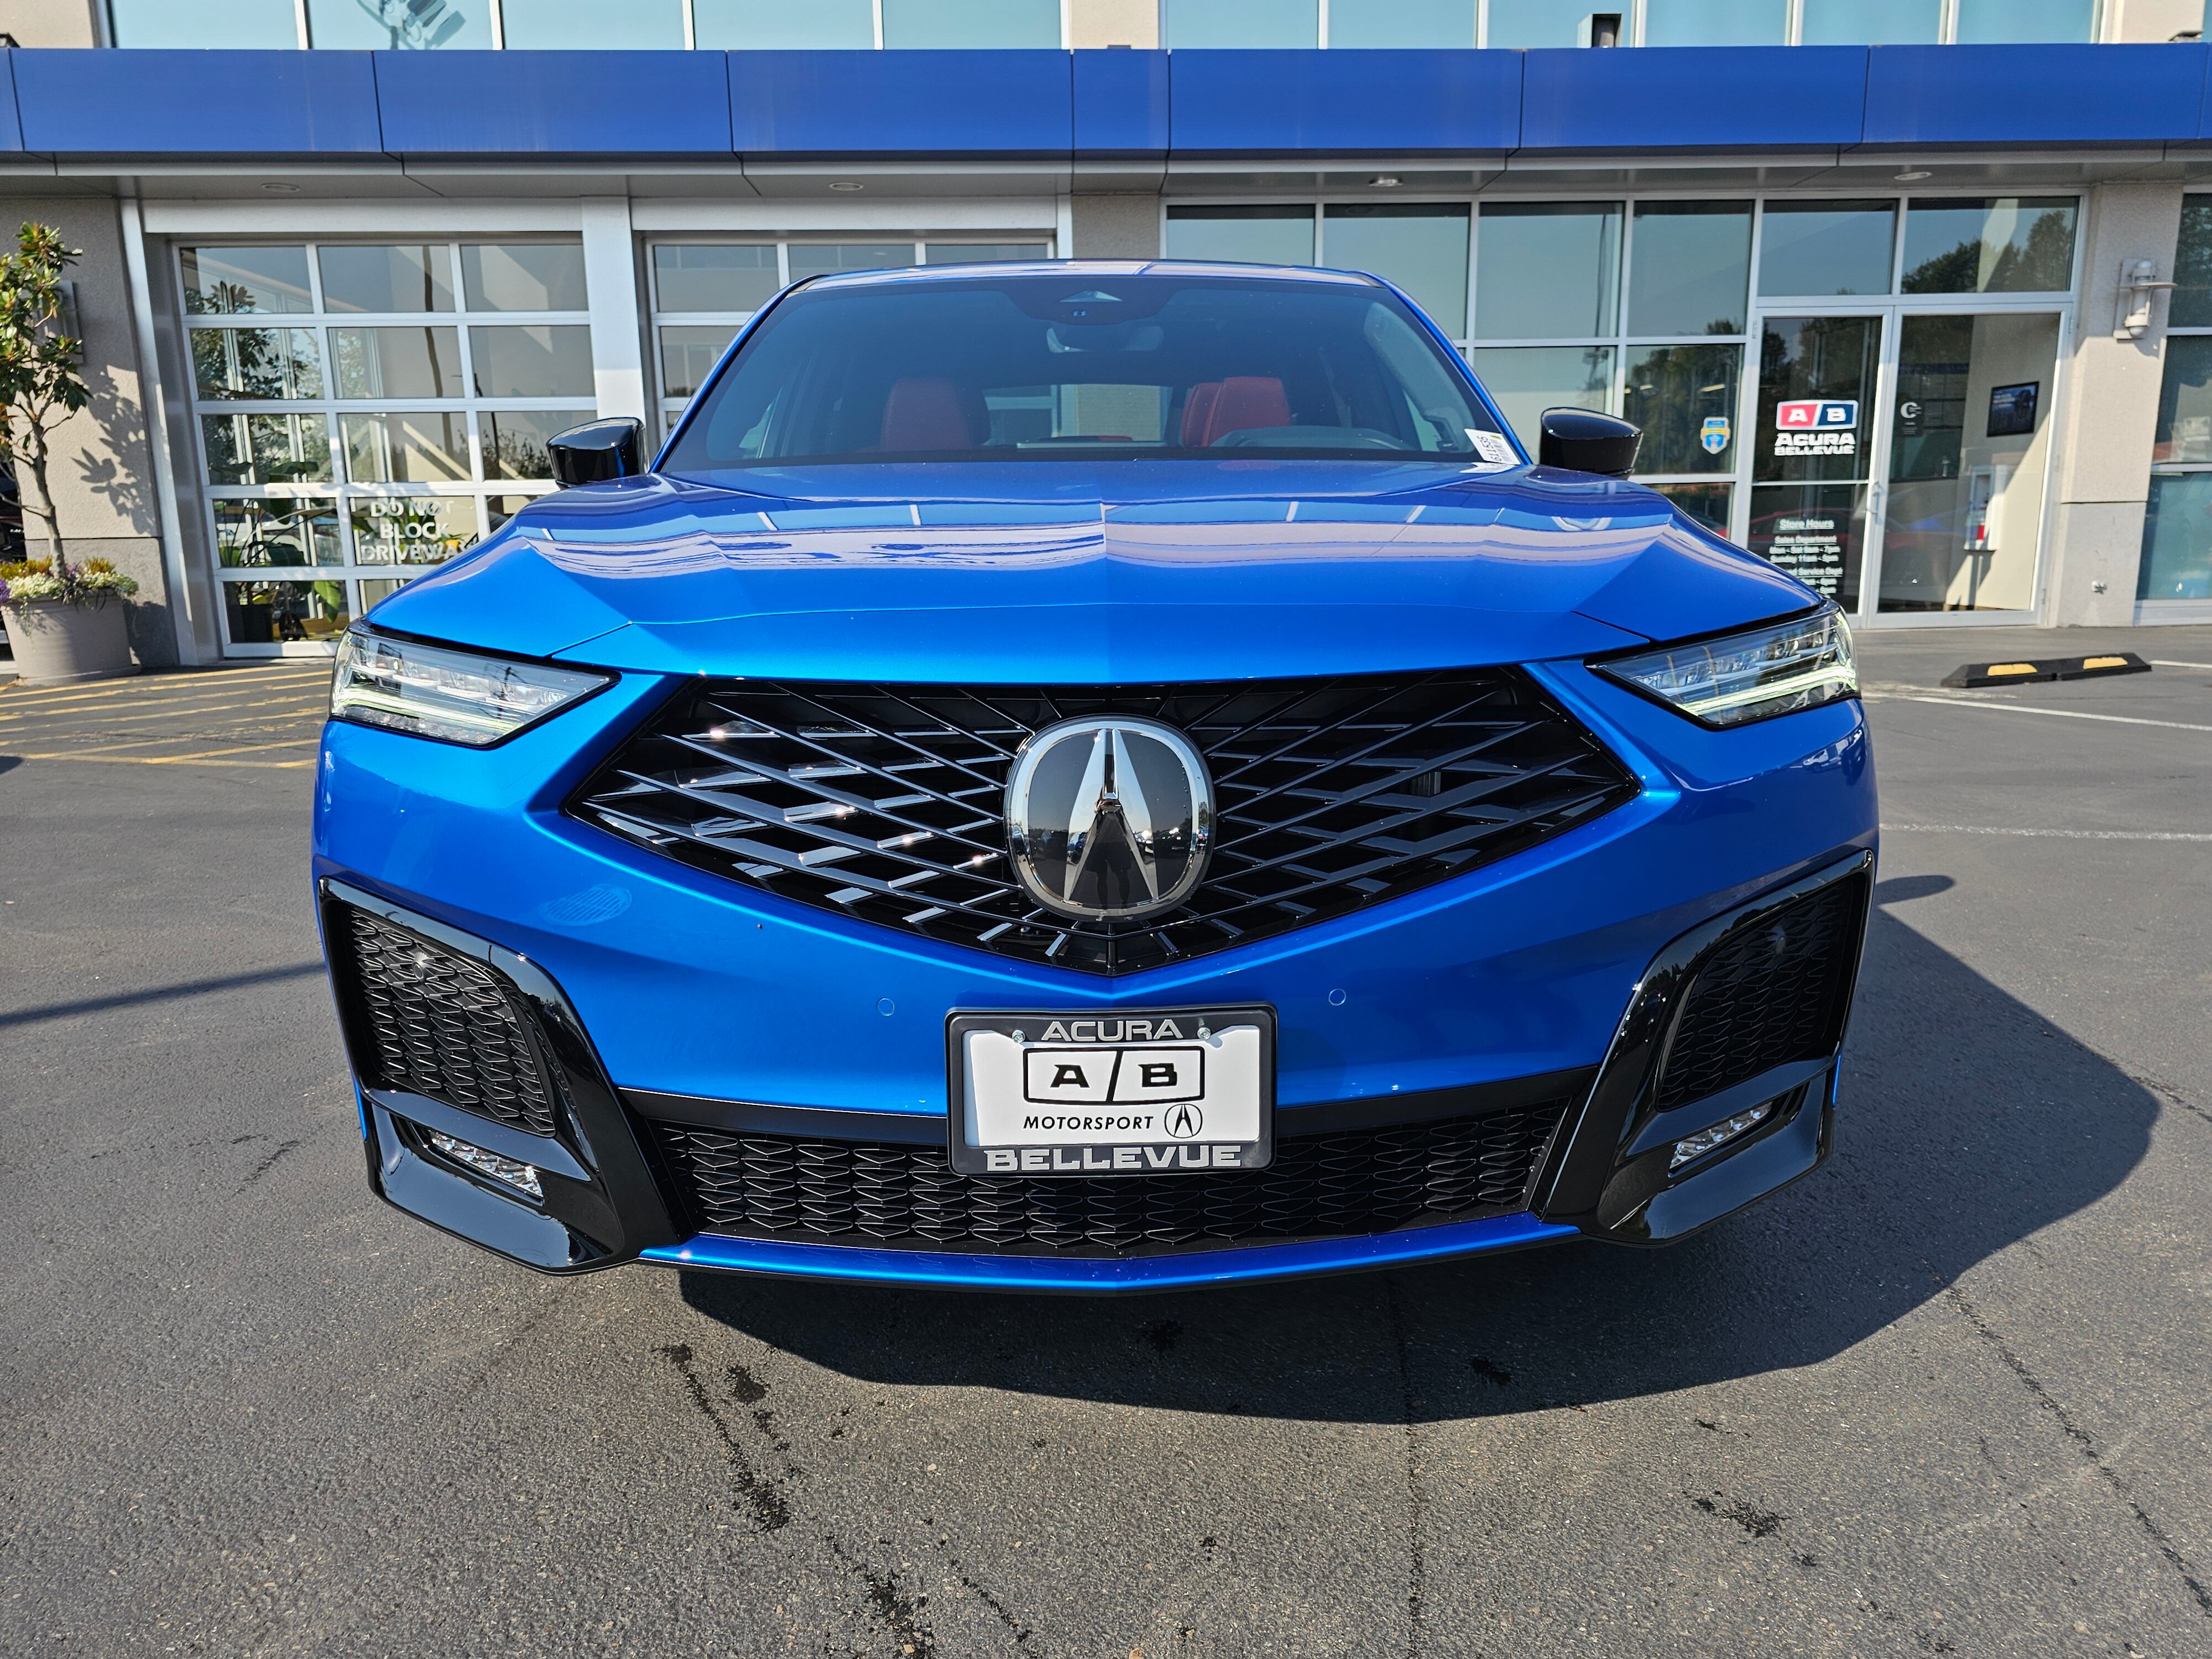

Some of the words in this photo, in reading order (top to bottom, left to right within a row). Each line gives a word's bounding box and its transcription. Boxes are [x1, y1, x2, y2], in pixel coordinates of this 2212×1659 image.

[1787, 408, 1808, 423] A
[1825, 408, 1845, 422] B
[1774, 432, 1856, 446] ACURA
[1774, 445, 1855, 456] BELLEVUE
[370, 501, 404, 518] DO
[409, 500, 455, 517] NOT
[380, 522, 451, 539] BLOCK
[1780, 519, 1805, 529] Store
[1806, 518, 1834, 528] Hours
[1041, 1019, 1183, 1043] ACURA
[1050, 1064, 1090, 1088] A
[1138, 1062, 1178, 1088] B
[1022, 1115, 1154, 1130] MOTORSPORT
[984, 1145, 1241, 1171] BELLEVUE
